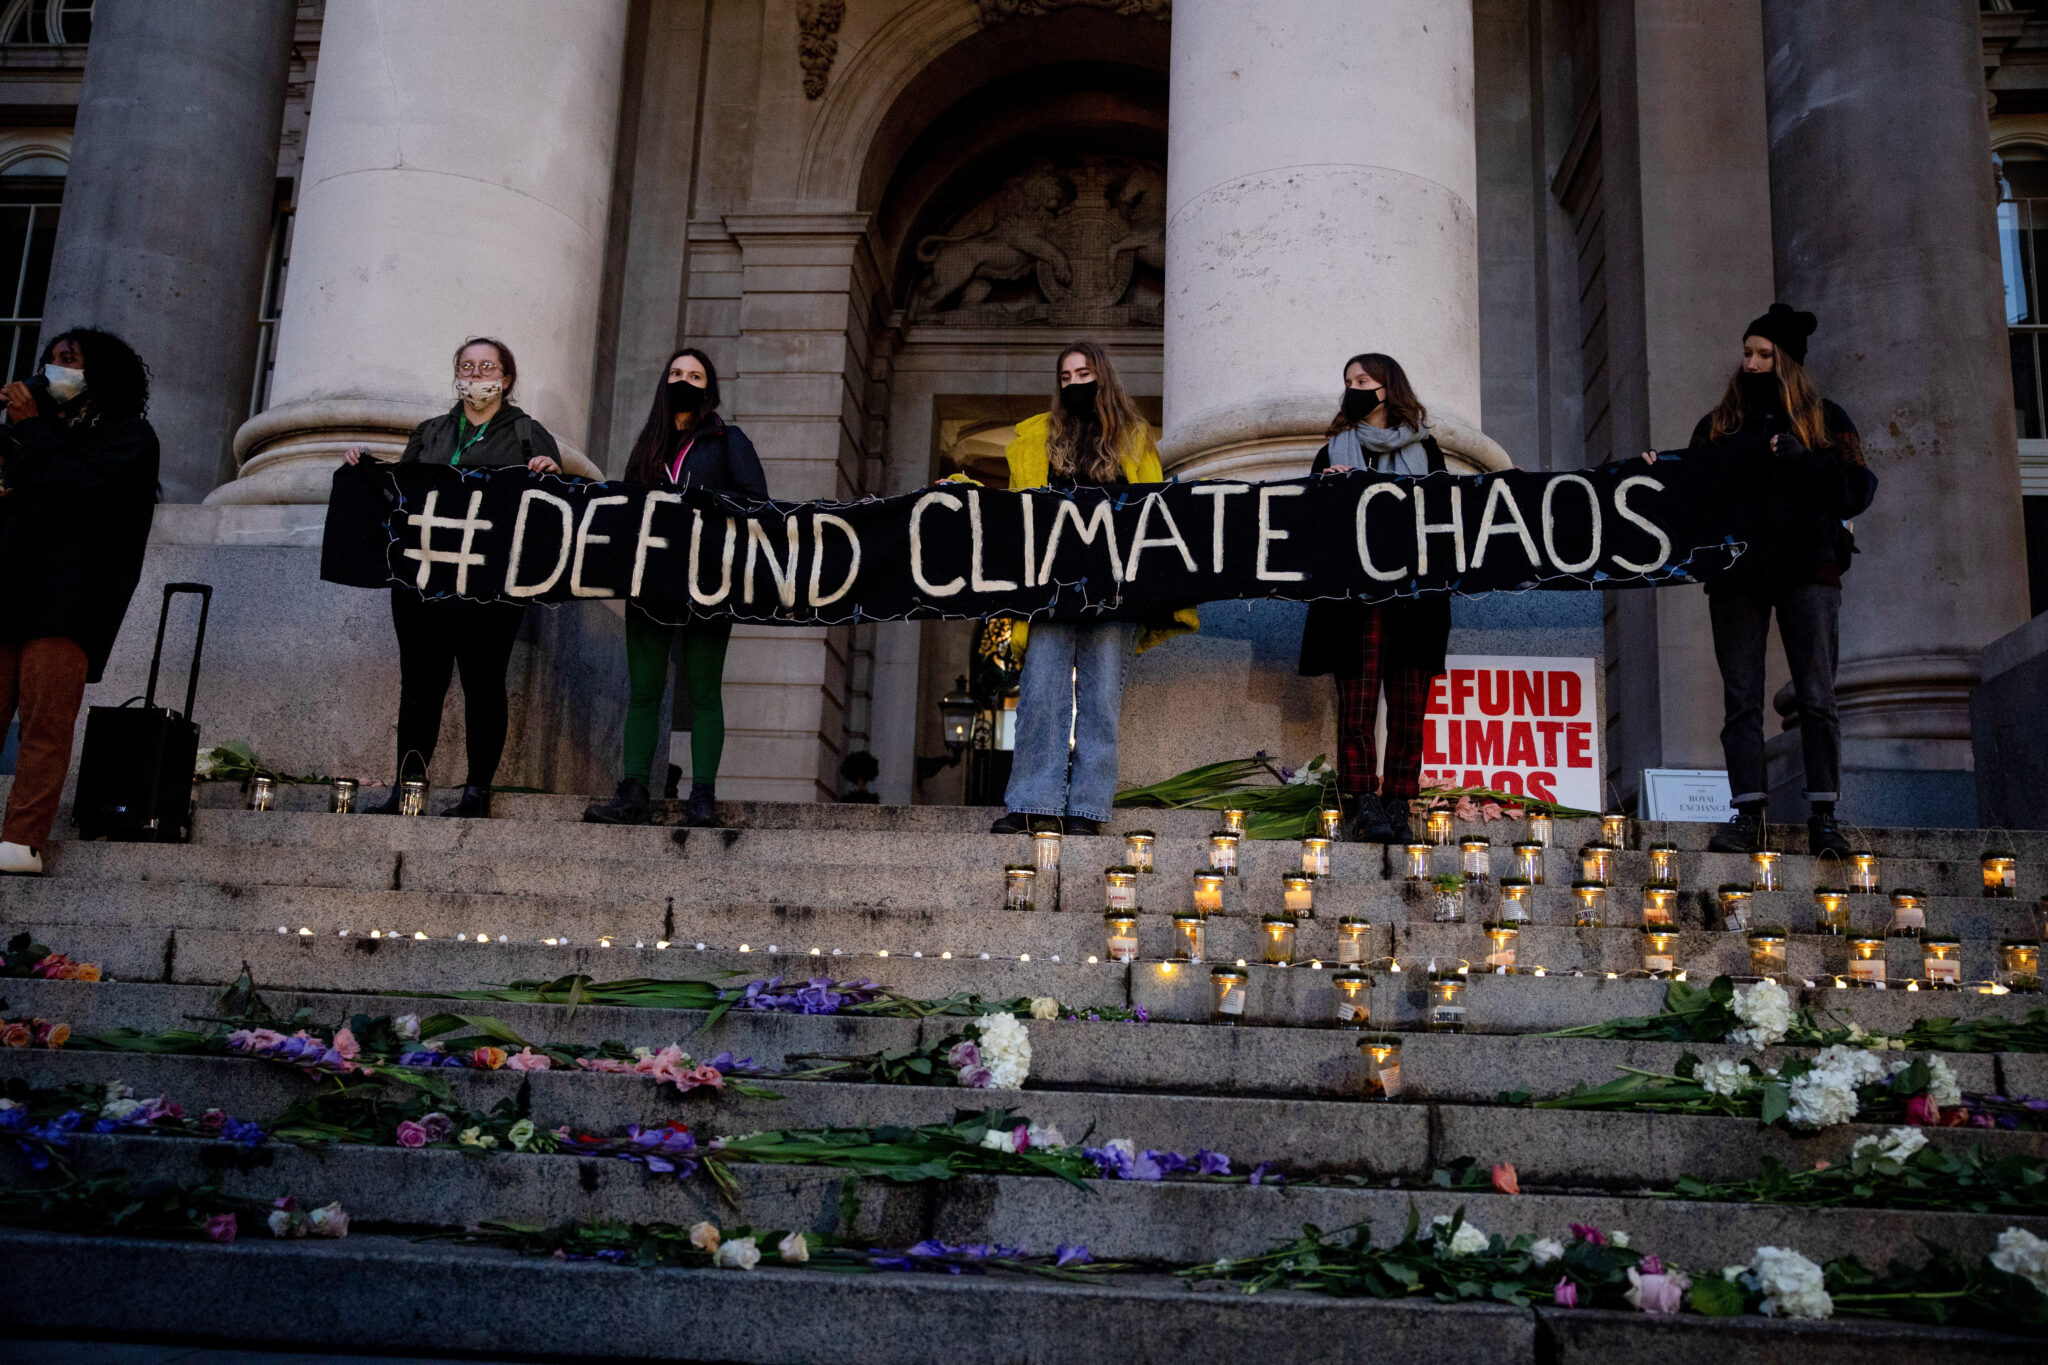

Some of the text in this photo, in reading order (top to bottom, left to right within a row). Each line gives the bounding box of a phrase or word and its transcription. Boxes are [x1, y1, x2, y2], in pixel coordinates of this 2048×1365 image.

[403, 474, 1671, 607] #DEFUND CLIMATE CHAOS
[1425, 669, 1582, 717] EFUND
[1422, 719, 1593, 768] LIMATE
